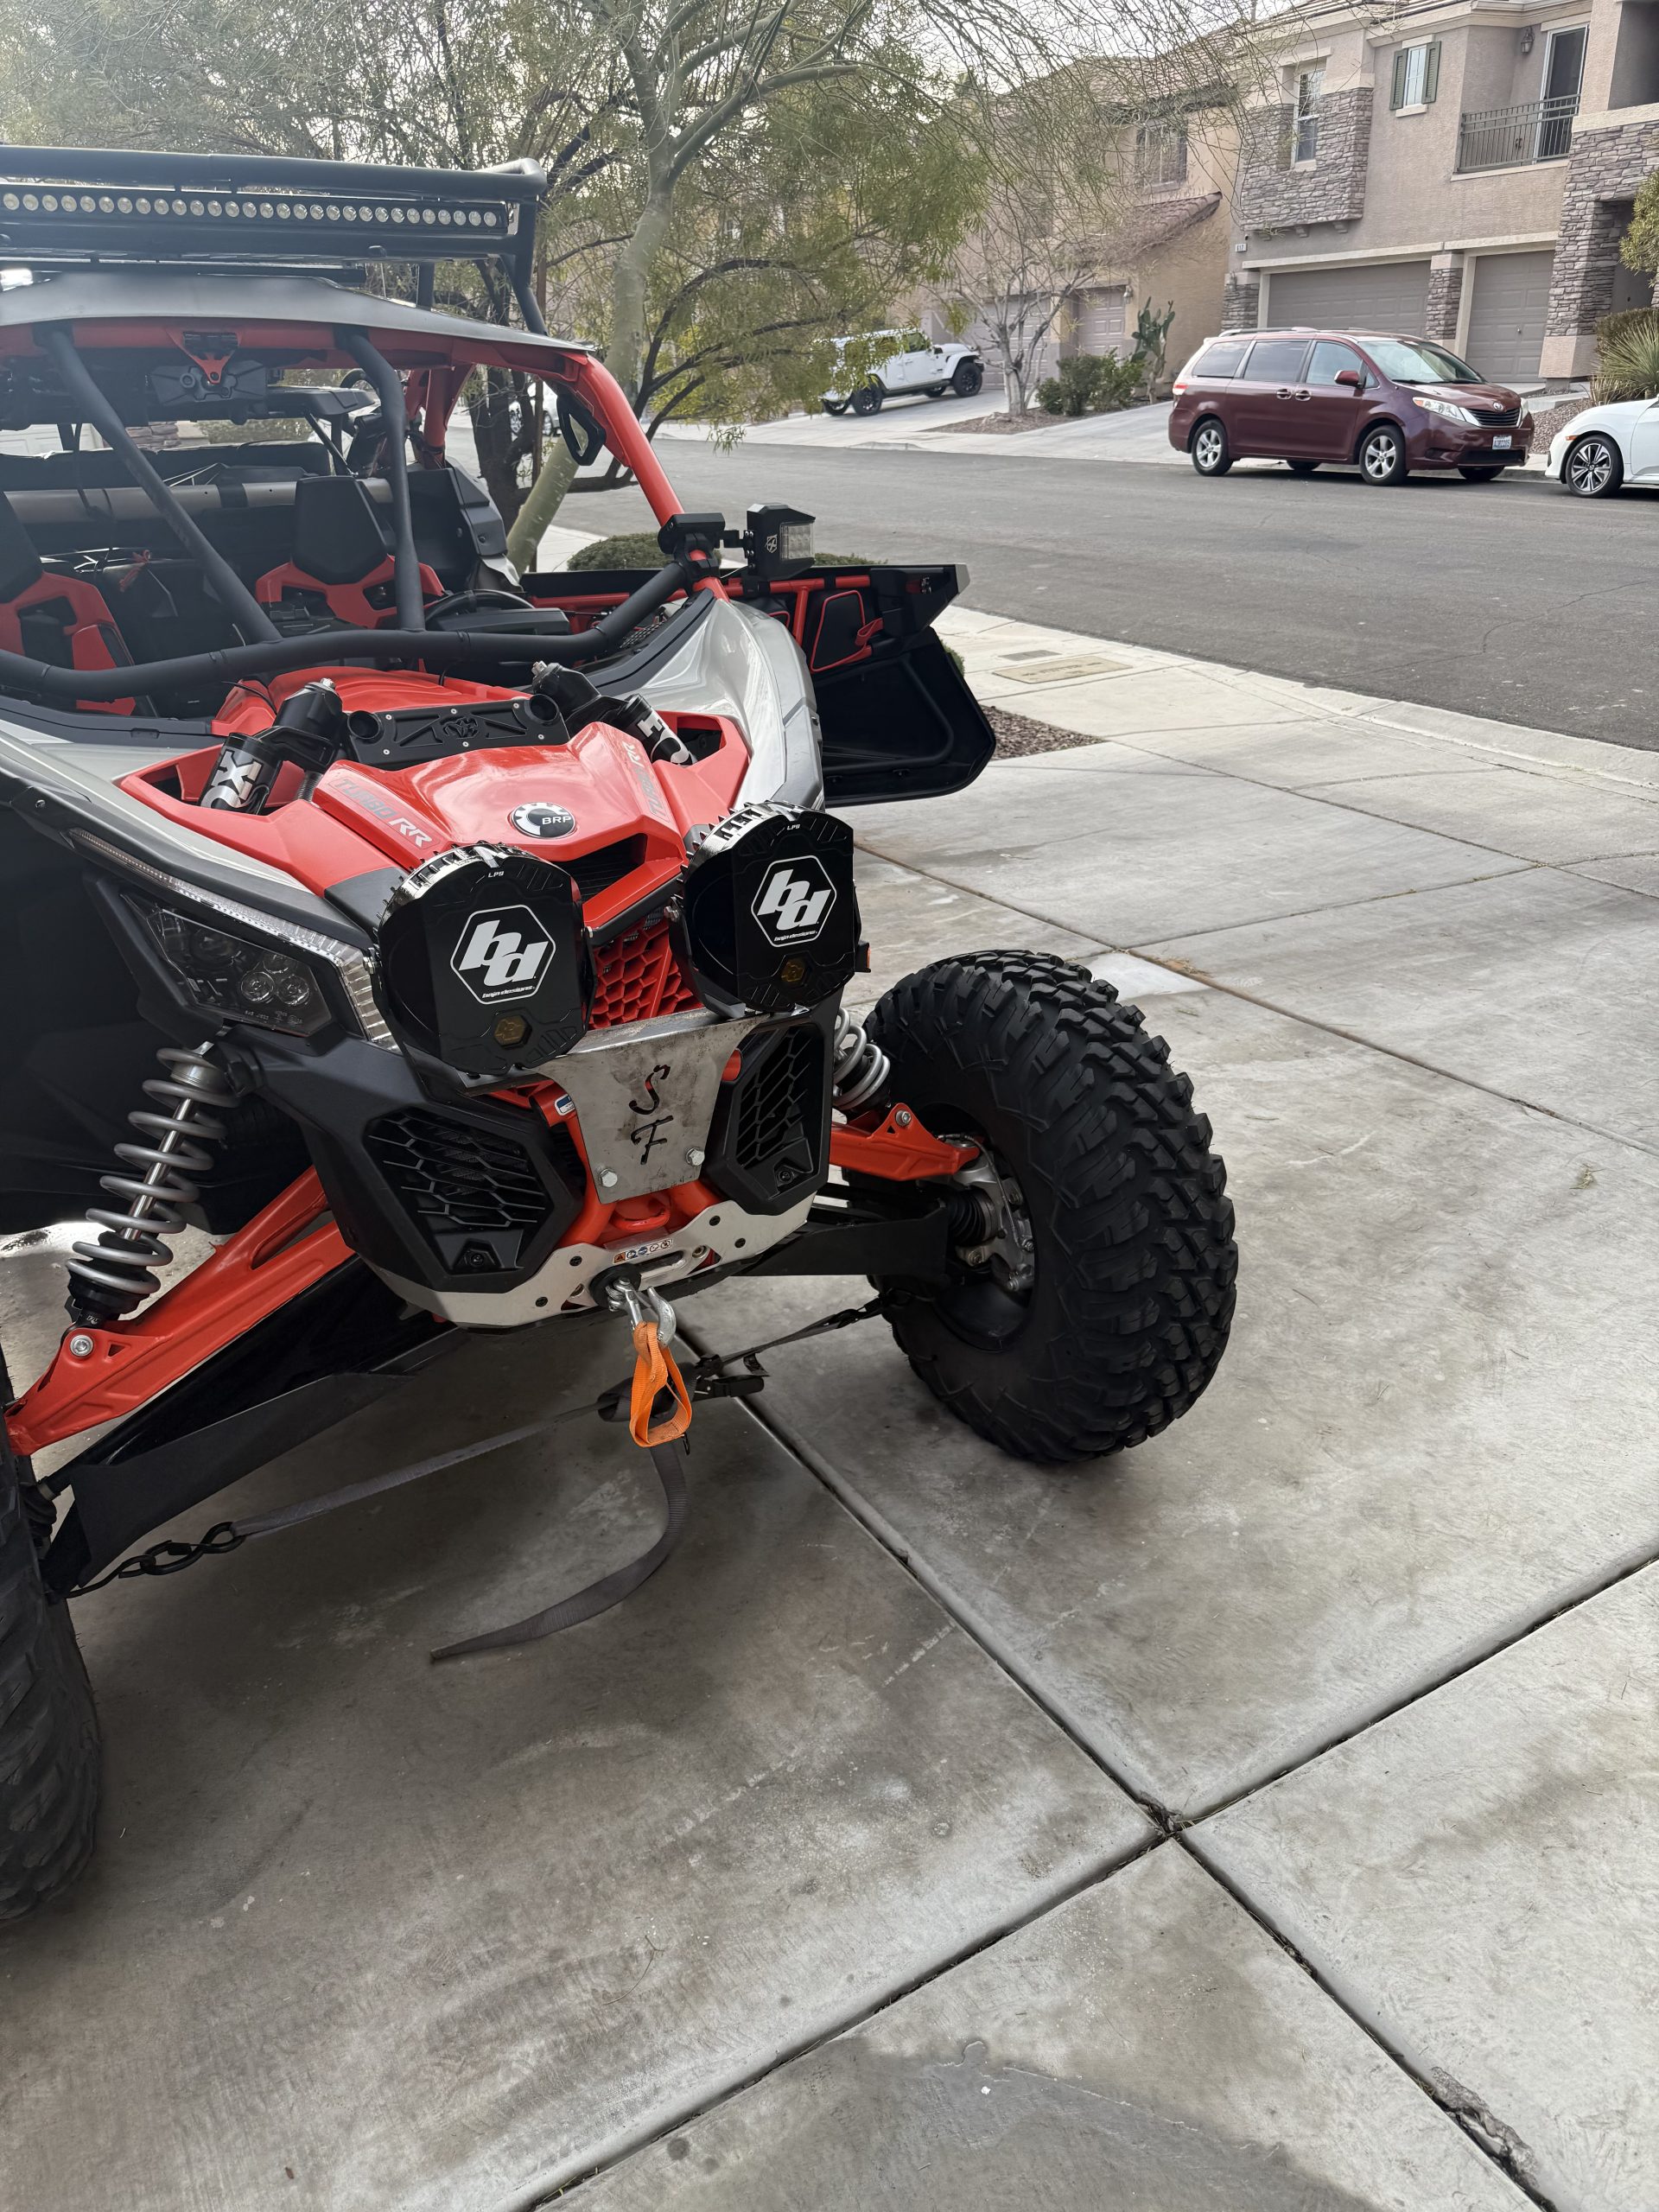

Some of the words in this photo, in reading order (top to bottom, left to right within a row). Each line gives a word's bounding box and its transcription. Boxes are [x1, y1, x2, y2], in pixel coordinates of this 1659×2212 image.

[637, 709, 694, 766] FO
[200, 750, 263, 809] OX
[334, 779, 398, 820] TURBO
[388, 817, 433, 848] RR
[542, 816, 572, 825] BRP
[757, 868, 831, 931] bd
[458, 919, 549, 987] bd
